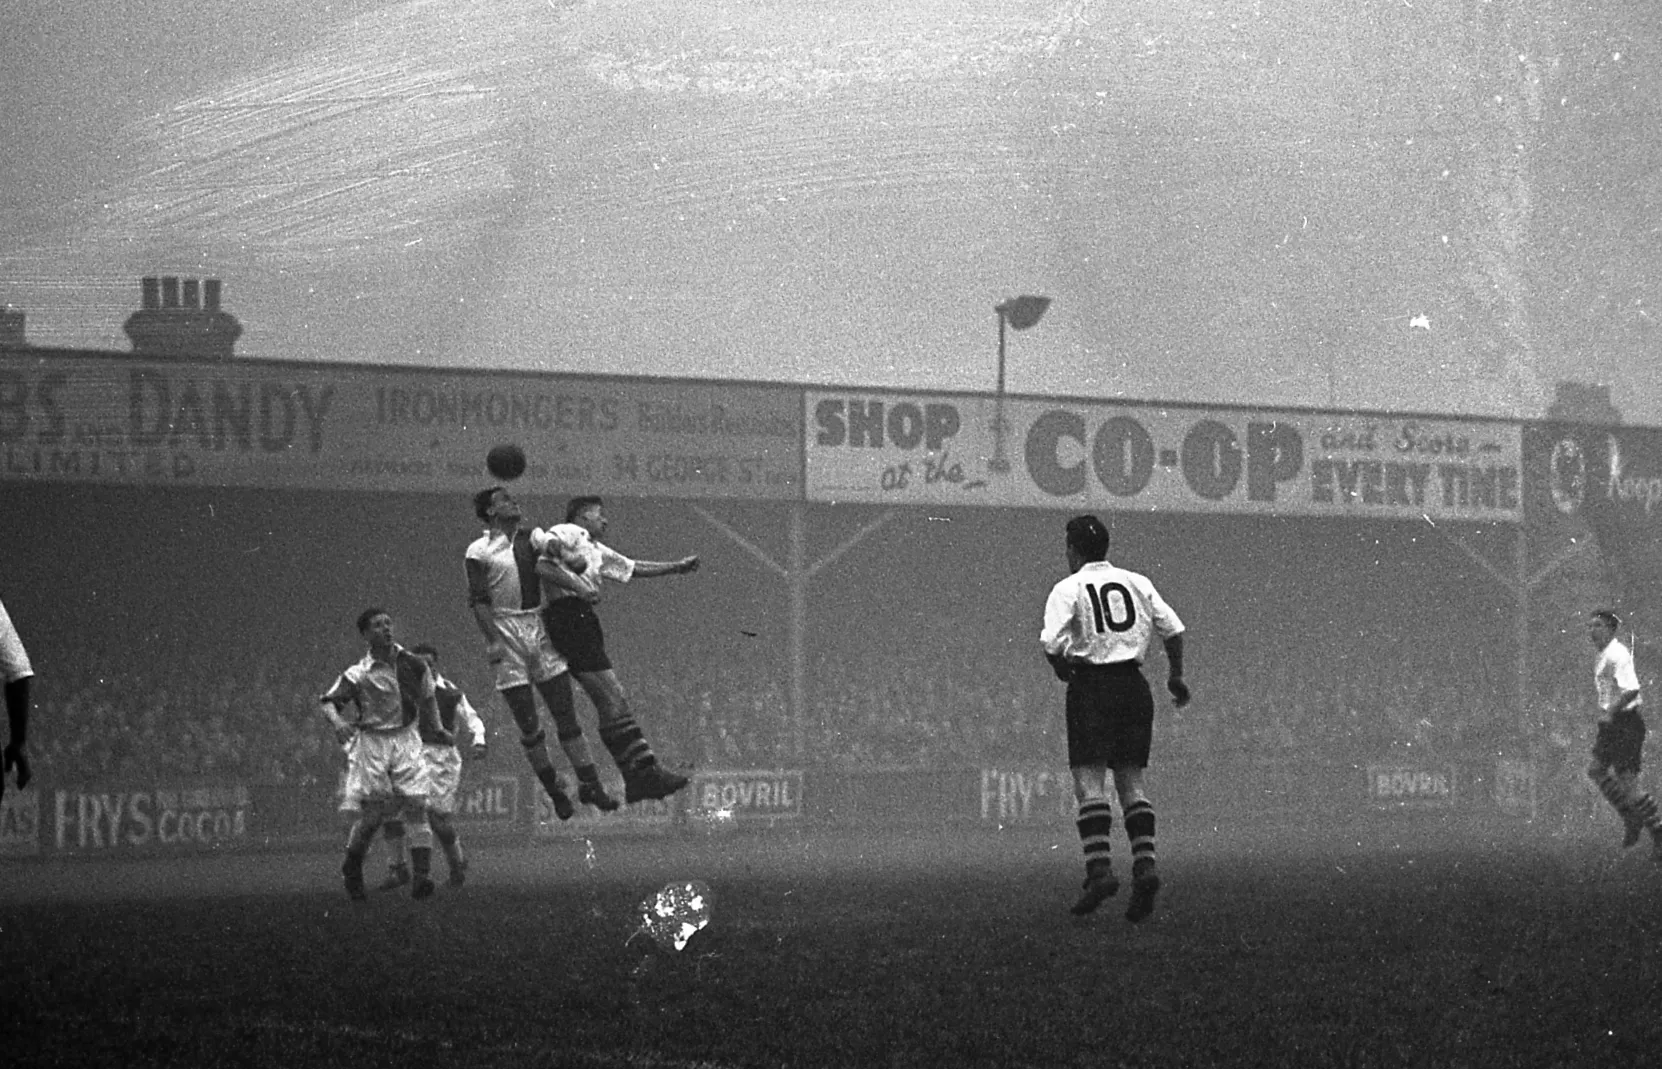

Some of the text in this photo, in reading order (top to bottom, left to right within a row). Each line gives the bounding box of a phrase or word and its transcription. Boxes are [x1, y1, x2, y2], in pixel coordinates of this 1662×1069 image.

[129, 368, 335, 454] DANDY
[376, 385, 618, 431] IRONMONGERS
[815, 398, 960, 450] SHOP
[5, 449, 197, 479] LIMITED
[880, 453, 966, 491] at the
[1024, 409, 1303, 501] CO-OP
[1312, 459, 1430, 506] EVERY
[1438, 463, 1519, 510] TIME
[1085, 582, 1137, 634] 10
[702, 780, 793, 808] BOVRIL
